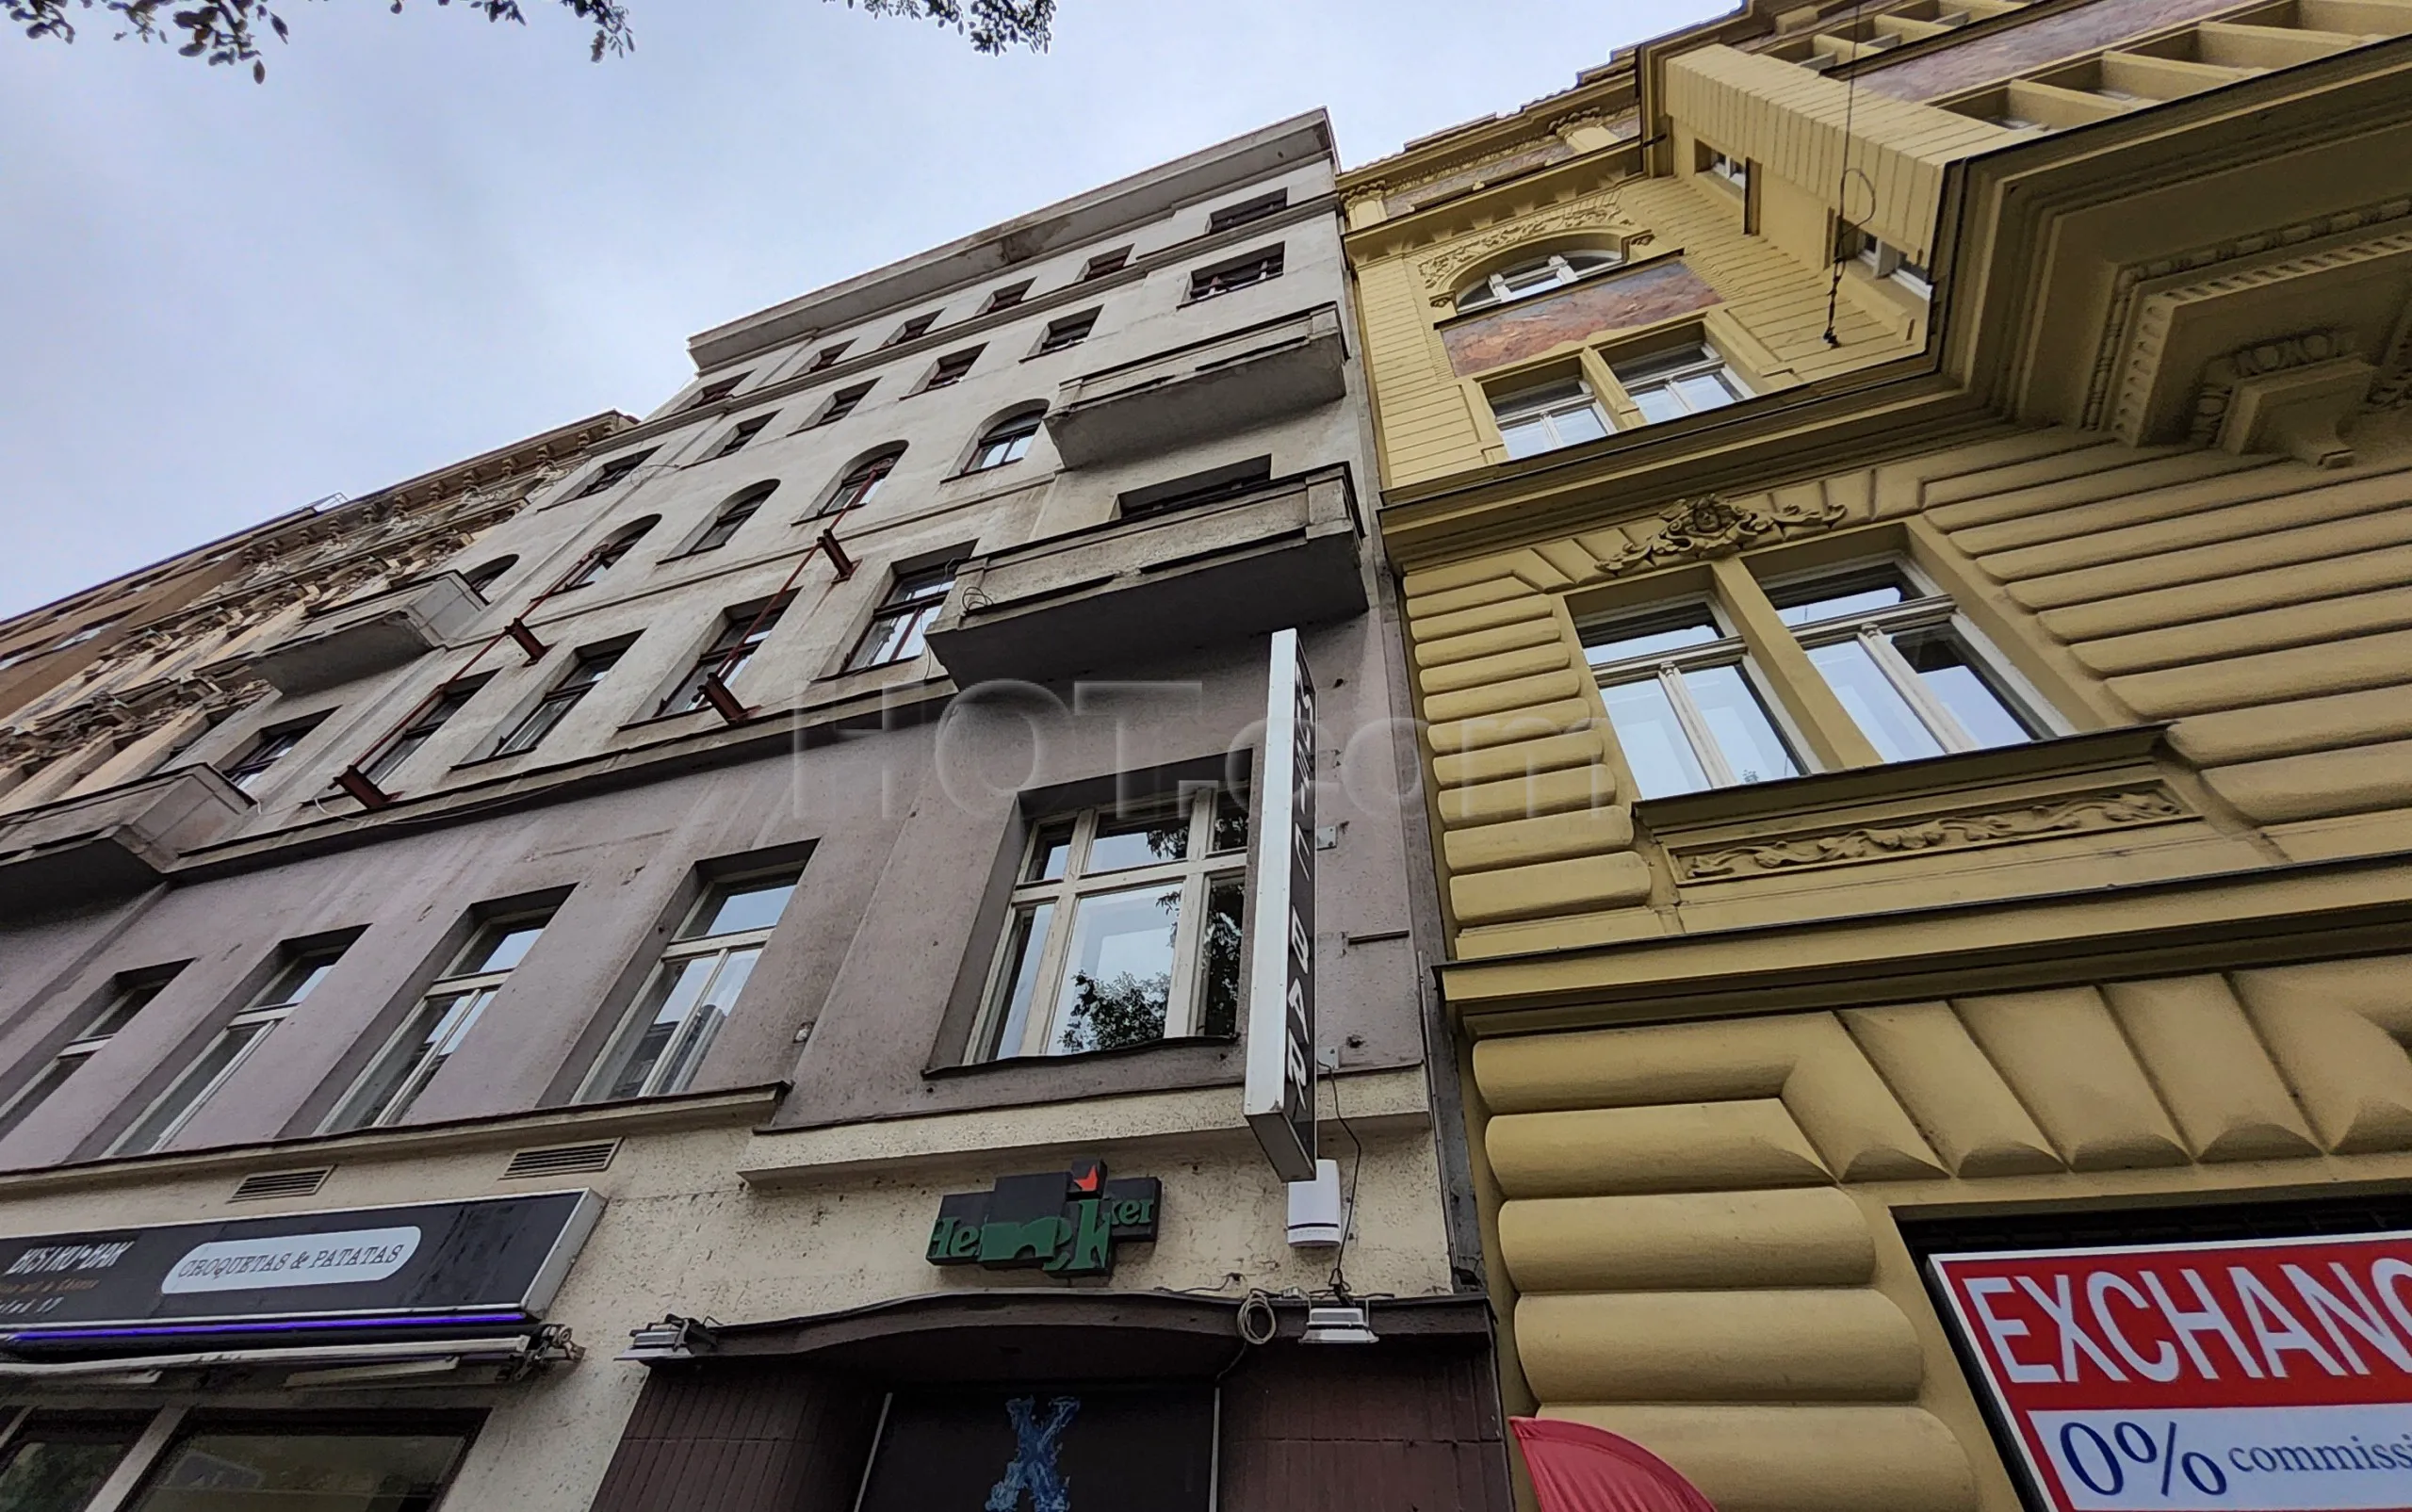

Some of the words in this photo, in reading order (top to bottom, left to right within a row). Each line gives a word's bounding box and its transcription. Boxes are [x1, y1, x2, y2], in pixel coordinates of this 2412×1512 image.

[1294, 660, 1313, 882] MUSIC
[1287, 904, 1311, 1111] BAR
[177, 1253, 289, 1280] CROQUETAS
[289, 1251, 310, 1270] &
[308, 1244, 404, 1269] PATATAS
[2059, 1421, 2227, 1498] 0%
